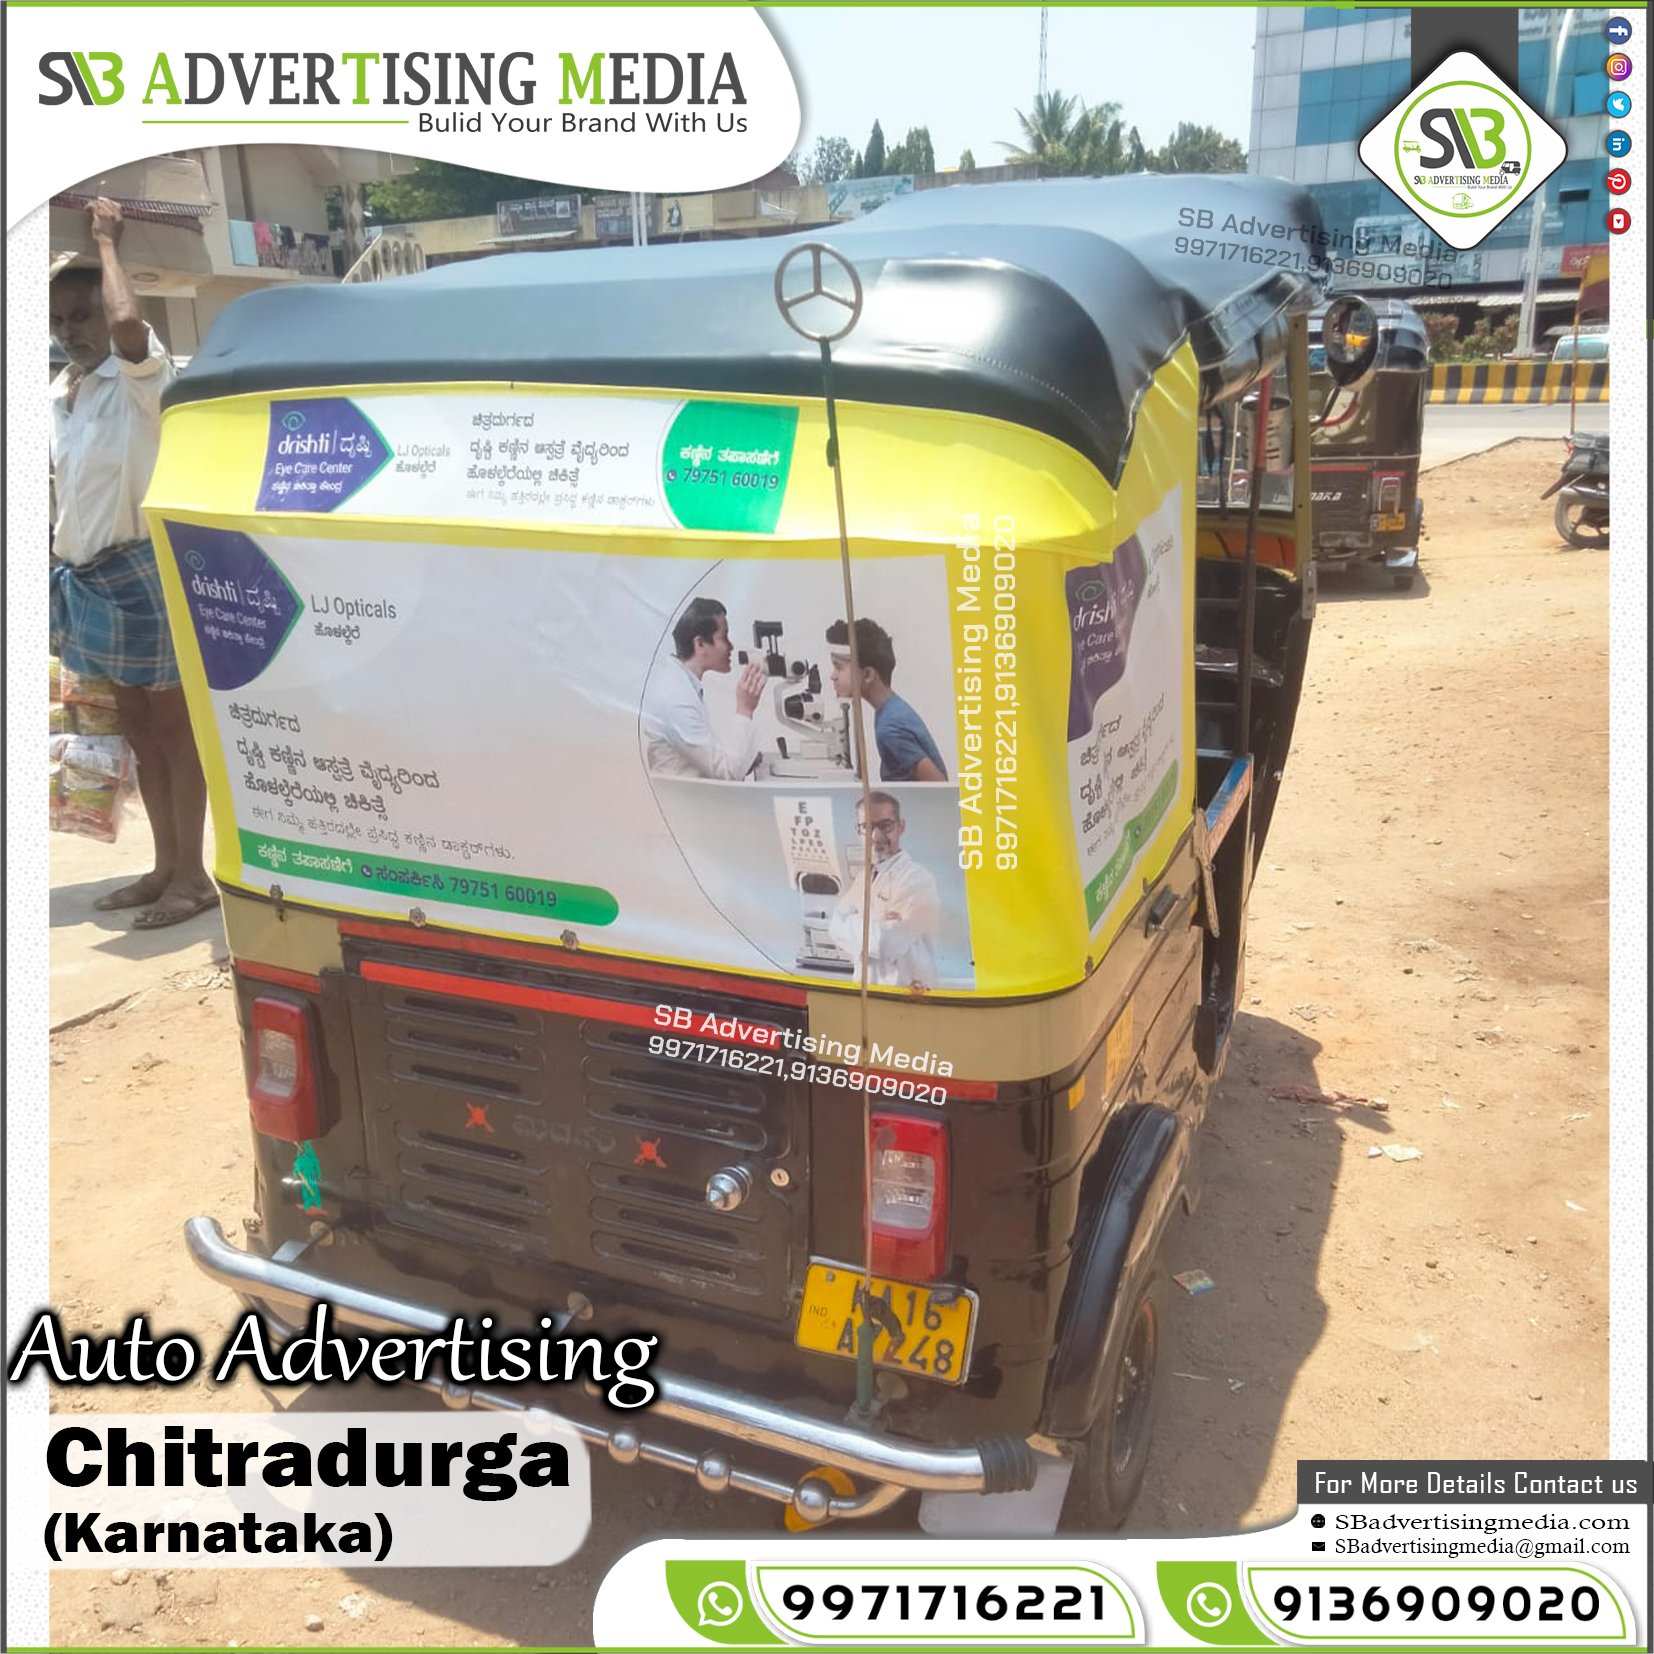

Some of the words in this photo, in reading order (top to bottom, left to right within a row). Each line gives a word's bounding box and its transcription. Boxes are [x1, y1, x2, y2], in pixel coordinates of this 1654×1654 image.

[278, 433, 330, 455] drishti
[275, 462, 292, 475] Eye
[294, 462, 317, 474] Care
[319, 462, 353, 474] Center
[683, 467, 727, 484] 79751
[731, 471, 779, 490] 60019
[192, 574, 237, 602] drishti
[215, 607, 236, 622] Care
[236, 612, 266, 628] Center
[310, 595, 330, 614] LJ
[333, 597, 397, 620] Opticals
[1087, 632, 1115, 647] Care
[229, 702, 300, 733] ಚಿತ್ರದುರ್ಗದ
[359, 760, 440, 795] ವೈದ್ಯರಿಂದ
[798, 801, 807, 814] E
[257, 843, 287, 868] ಕಣ್ಣಿನ
[292, 851, 353, 874] ತಪಾಸಣೆಗೆ
[450, 876, 499, 899] 79751
[505, 885, 557, 908] 60019
